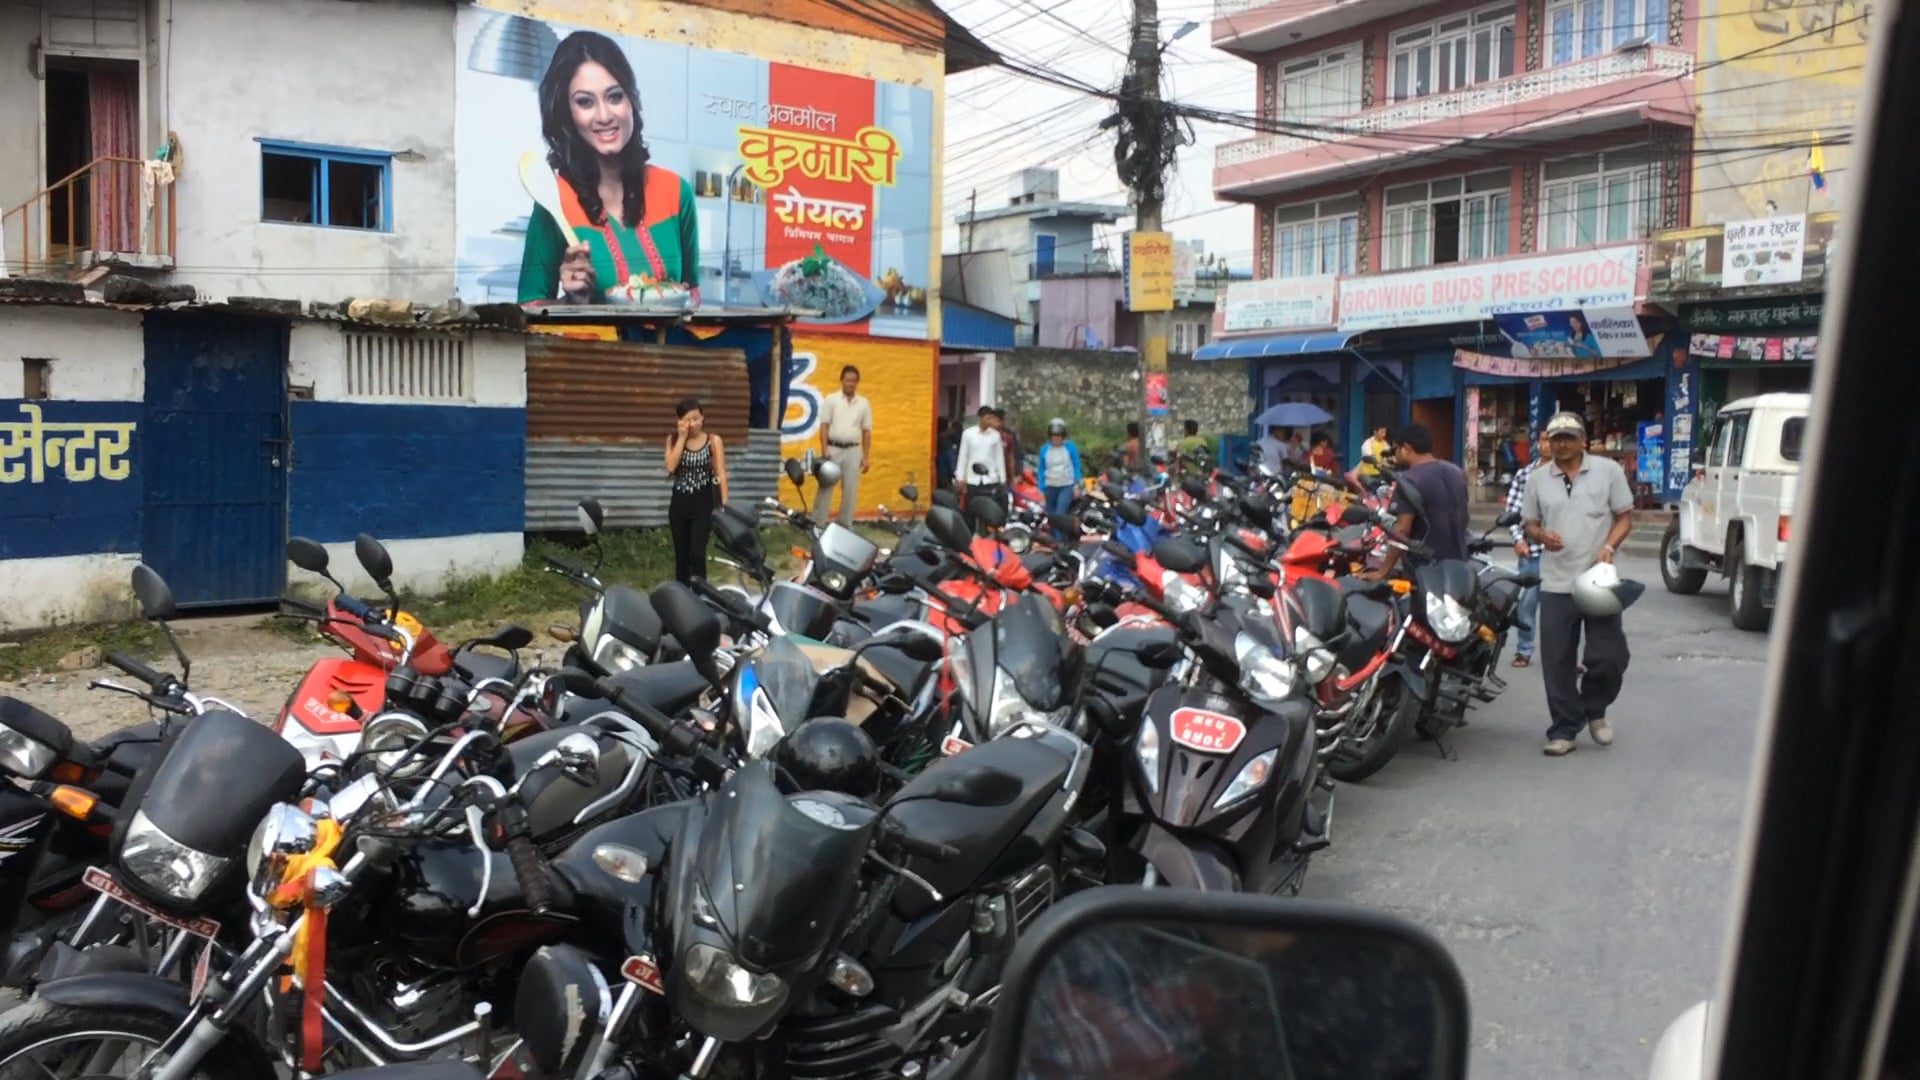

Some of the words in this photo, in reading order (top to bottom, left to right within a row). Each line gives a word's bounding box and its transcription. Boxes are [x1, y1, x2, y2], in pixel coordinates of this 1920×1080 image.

[761, 103, 837, 133] अनमोल
[737, 125, 902, 187] कुमारी
[773, 186, 866, 231] रोयल
[1343, 282, 1426, 313] GROWING
[1432, 275, 1484, 305] BUDS
[1491, 260, 1630, 299] PRE-SCHOOL
